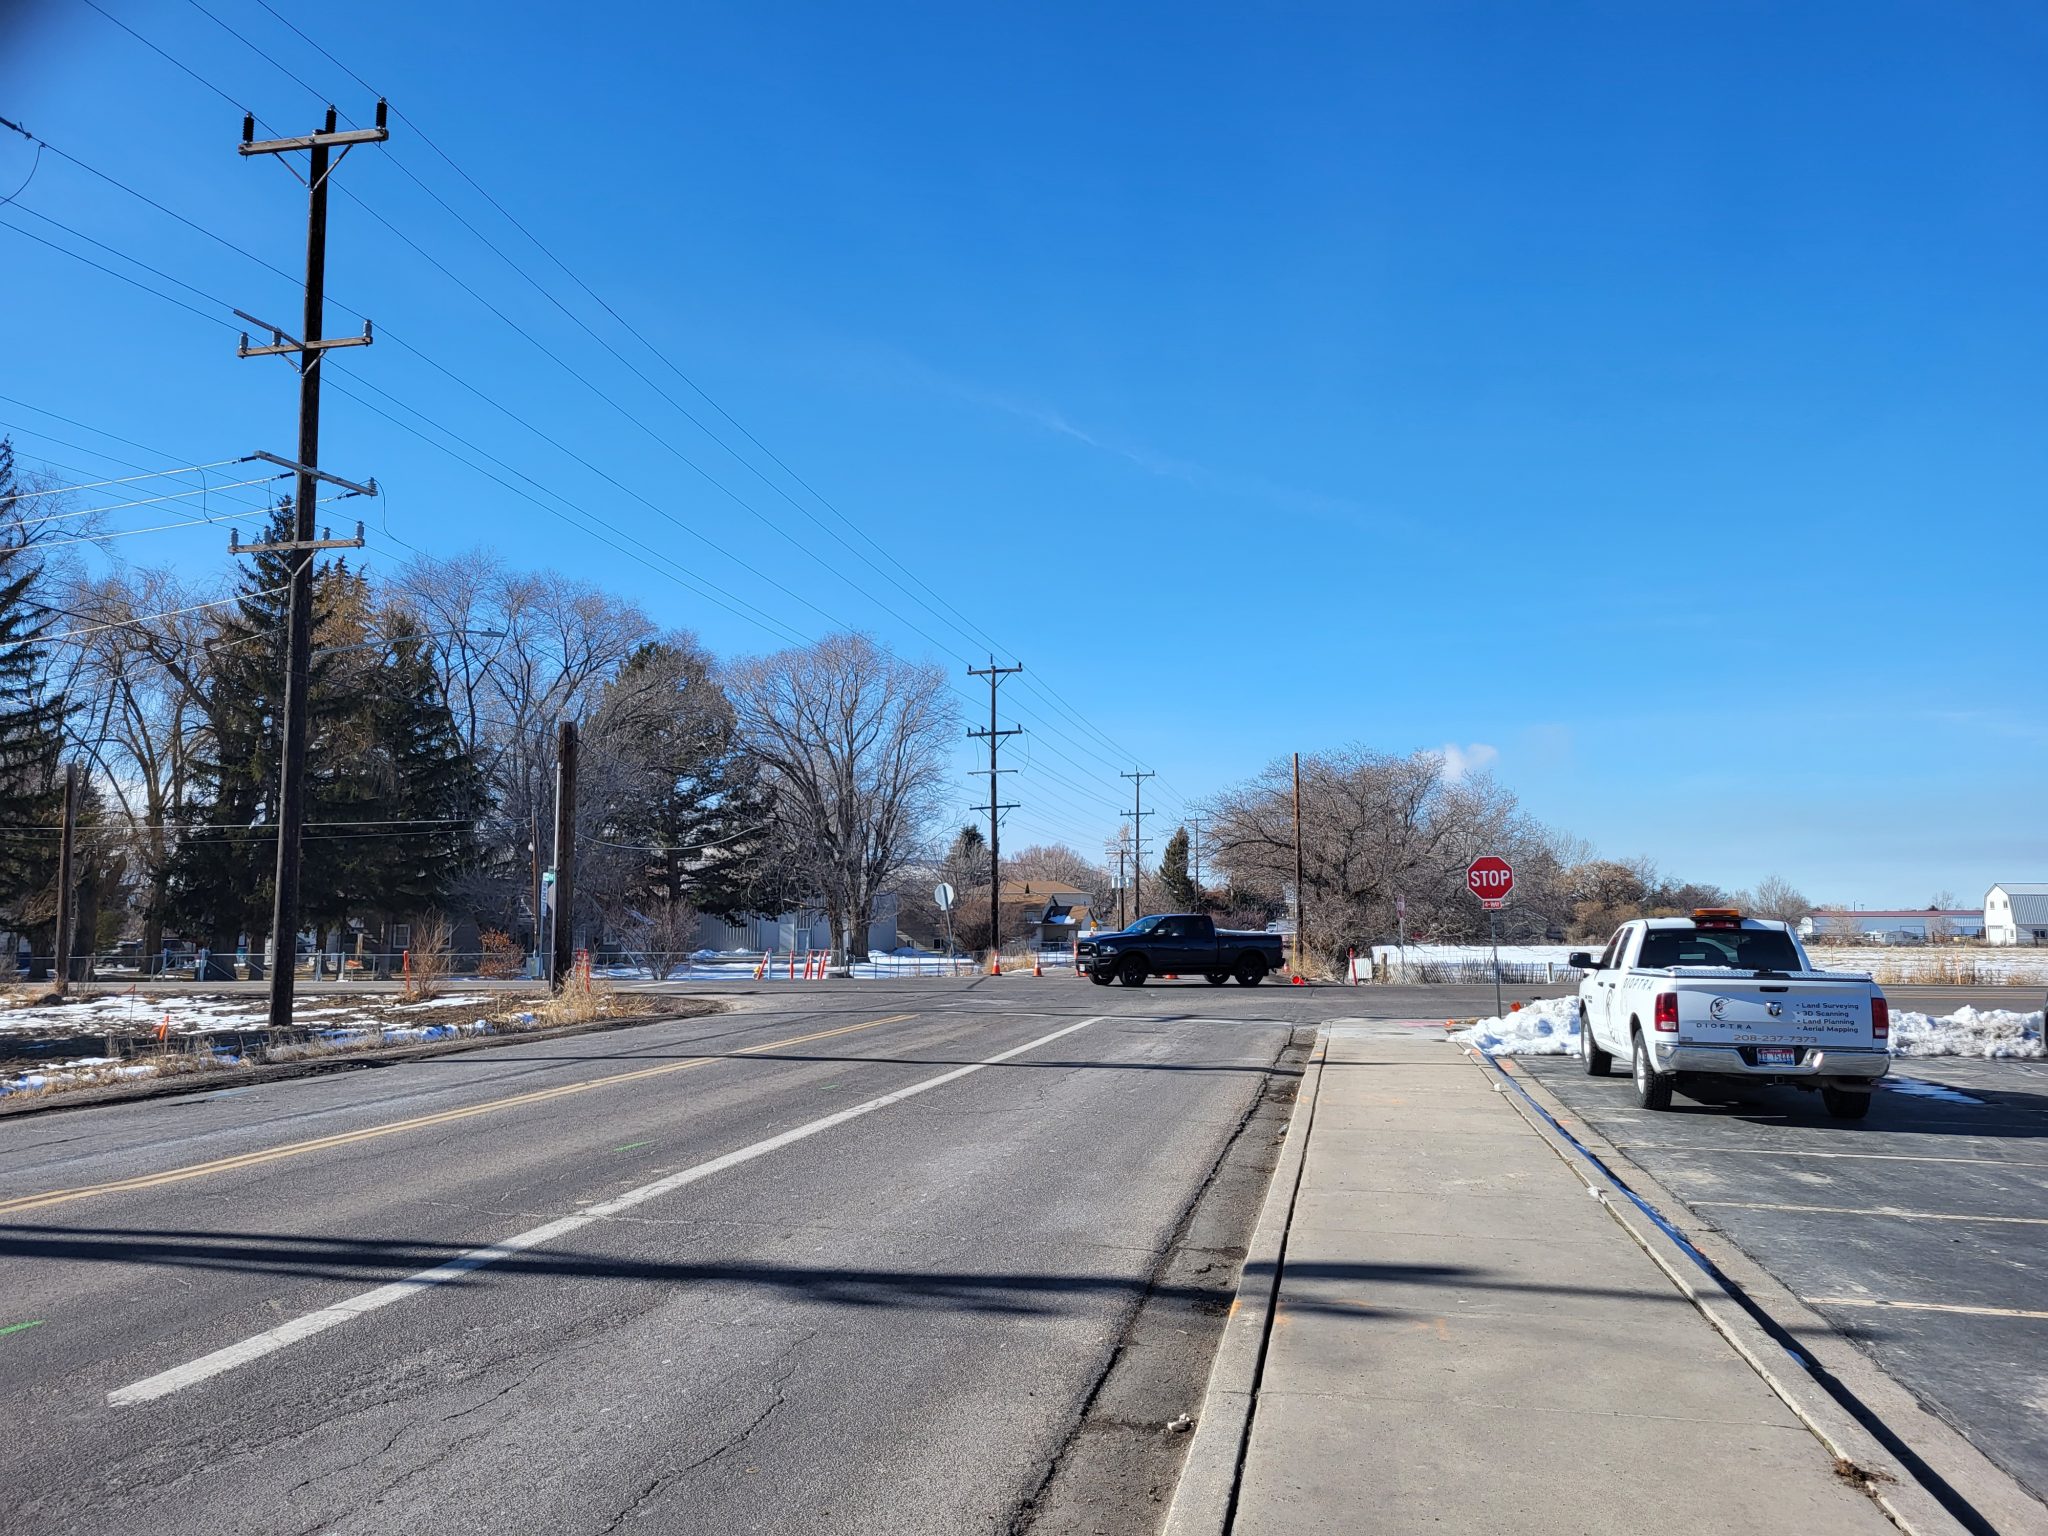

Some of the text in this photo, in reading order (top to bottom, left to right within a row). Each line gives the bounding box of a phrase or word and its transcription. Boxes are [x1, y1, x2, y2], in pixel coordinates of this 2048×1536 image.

[1471, 870, 1510, 887] STOP
[1623, 978, 1654, 991] DIOPTRA
[1822, 1002, 1859, 1011] Surveying
[1815, 1010, 1849, 1018] Scanning
[1824, 1018, 1855, 1026] Planning
[1826, 1025, 1859, 1034] Mapping
[1733, 1034, 1818, 1043] 208-237-7373
